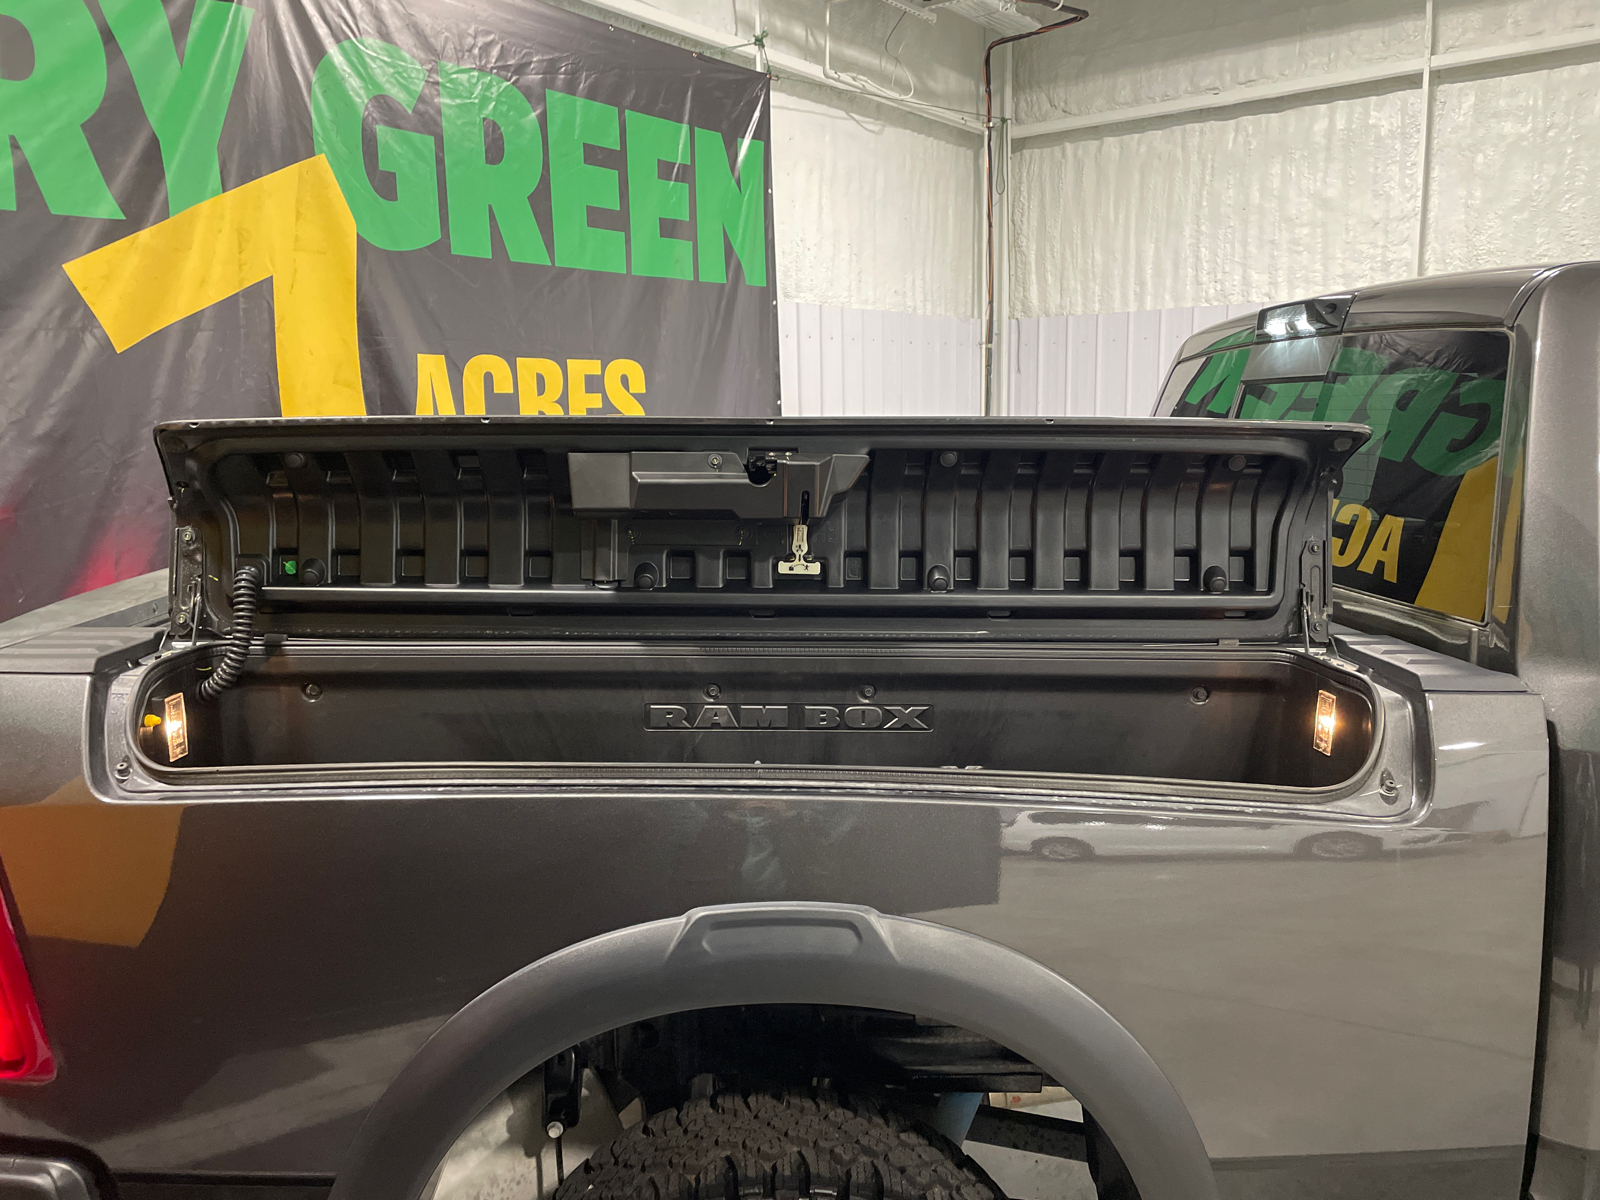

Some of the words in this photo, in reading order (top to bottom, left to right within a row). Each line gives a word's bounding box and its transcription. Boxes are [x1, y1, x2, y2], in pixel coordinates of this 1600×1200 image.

[311, 37, 767, 287] GREEN
[416, 353, 646, 416] ACRES
[650, 704, 788, 729] RAM
[804, 705, 930, 730] BOX
